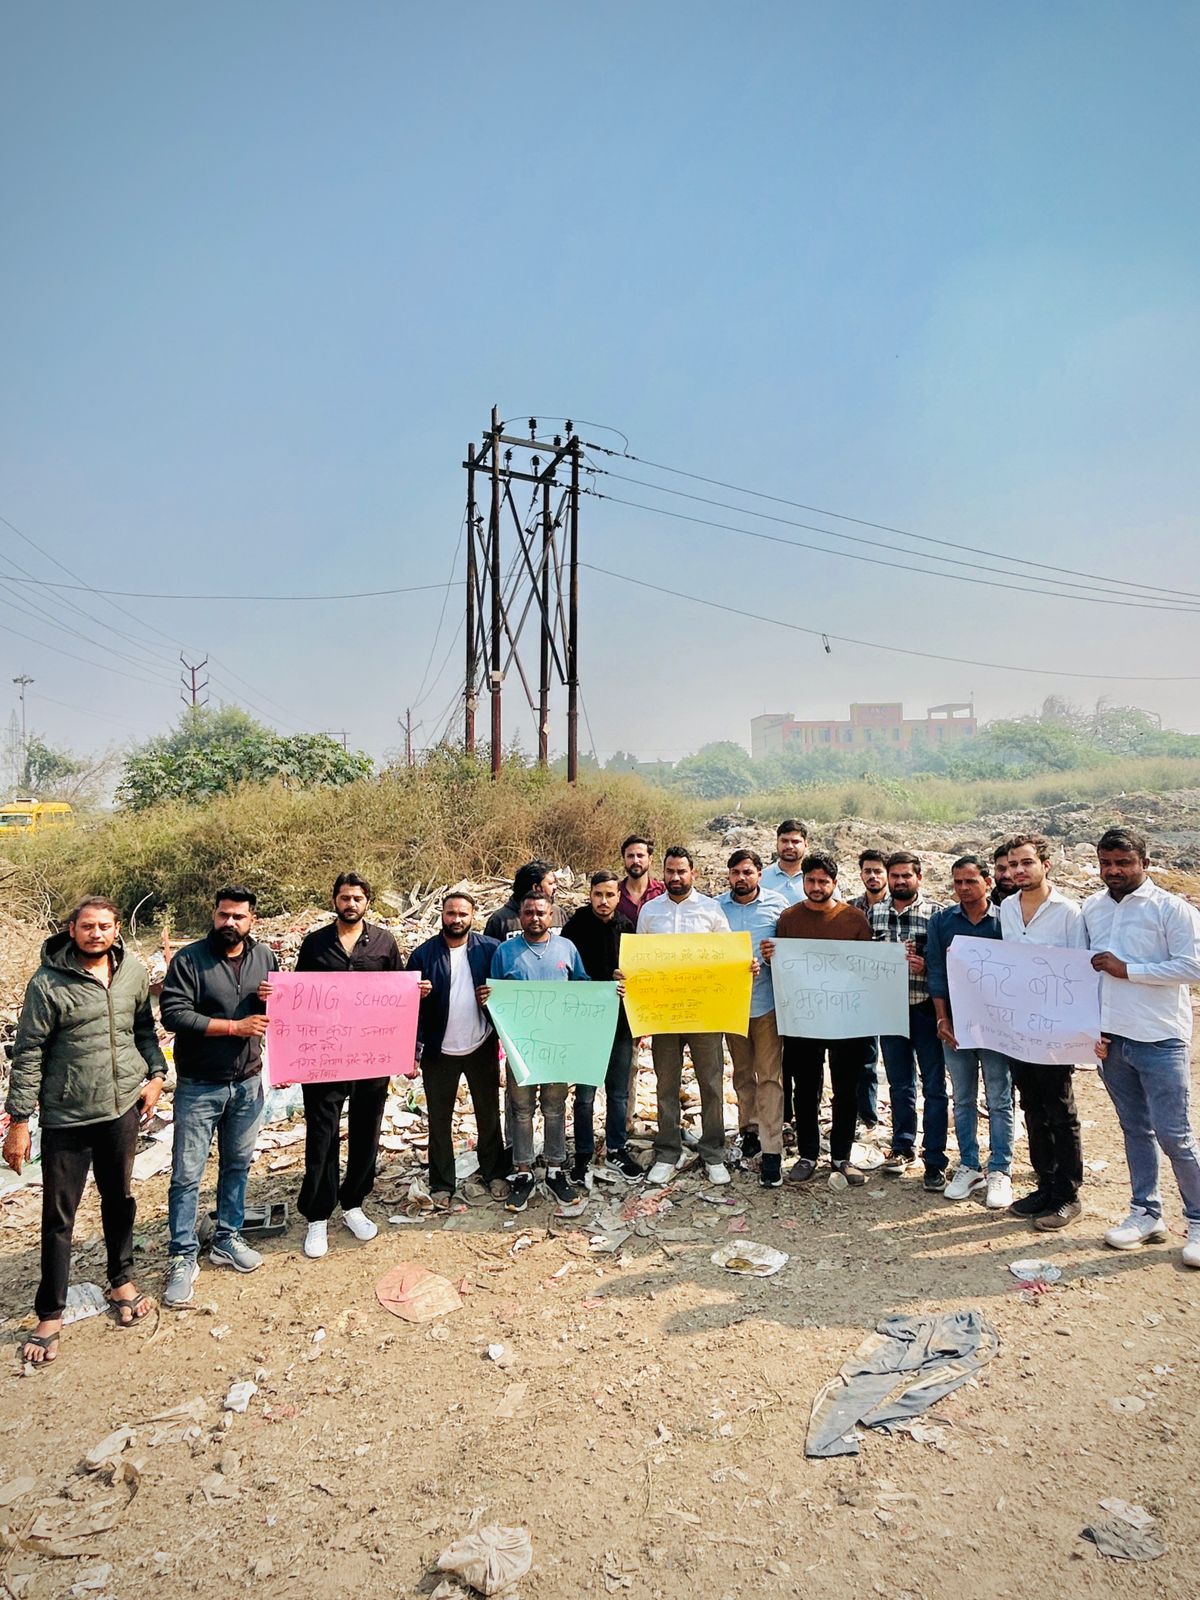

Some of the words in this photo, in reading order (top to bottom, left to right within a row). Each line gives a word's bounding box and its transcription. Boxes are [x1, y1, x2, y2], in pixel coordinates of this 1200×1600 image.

[782, 951, 840, 975] नगर
[846, 954, 904, 982] आयुक्त
[292, 982, 340, 1011] BNG
[354, 991, 407, 1009] SCHOOL
[495, 989, 557, 1022] नगर
[563, 993, 606, 1019] निगम
[793, 981, 869, 1023] मुर्दाबाद
[275, 1019, 291, 1037] के
[296, 1024, 324, 1037] पास
[984, 1003, 1015, 1027] हाय
[1027, 1013, 1063, 1033] हाय
[290, 1056, 317, 1069] नगर
